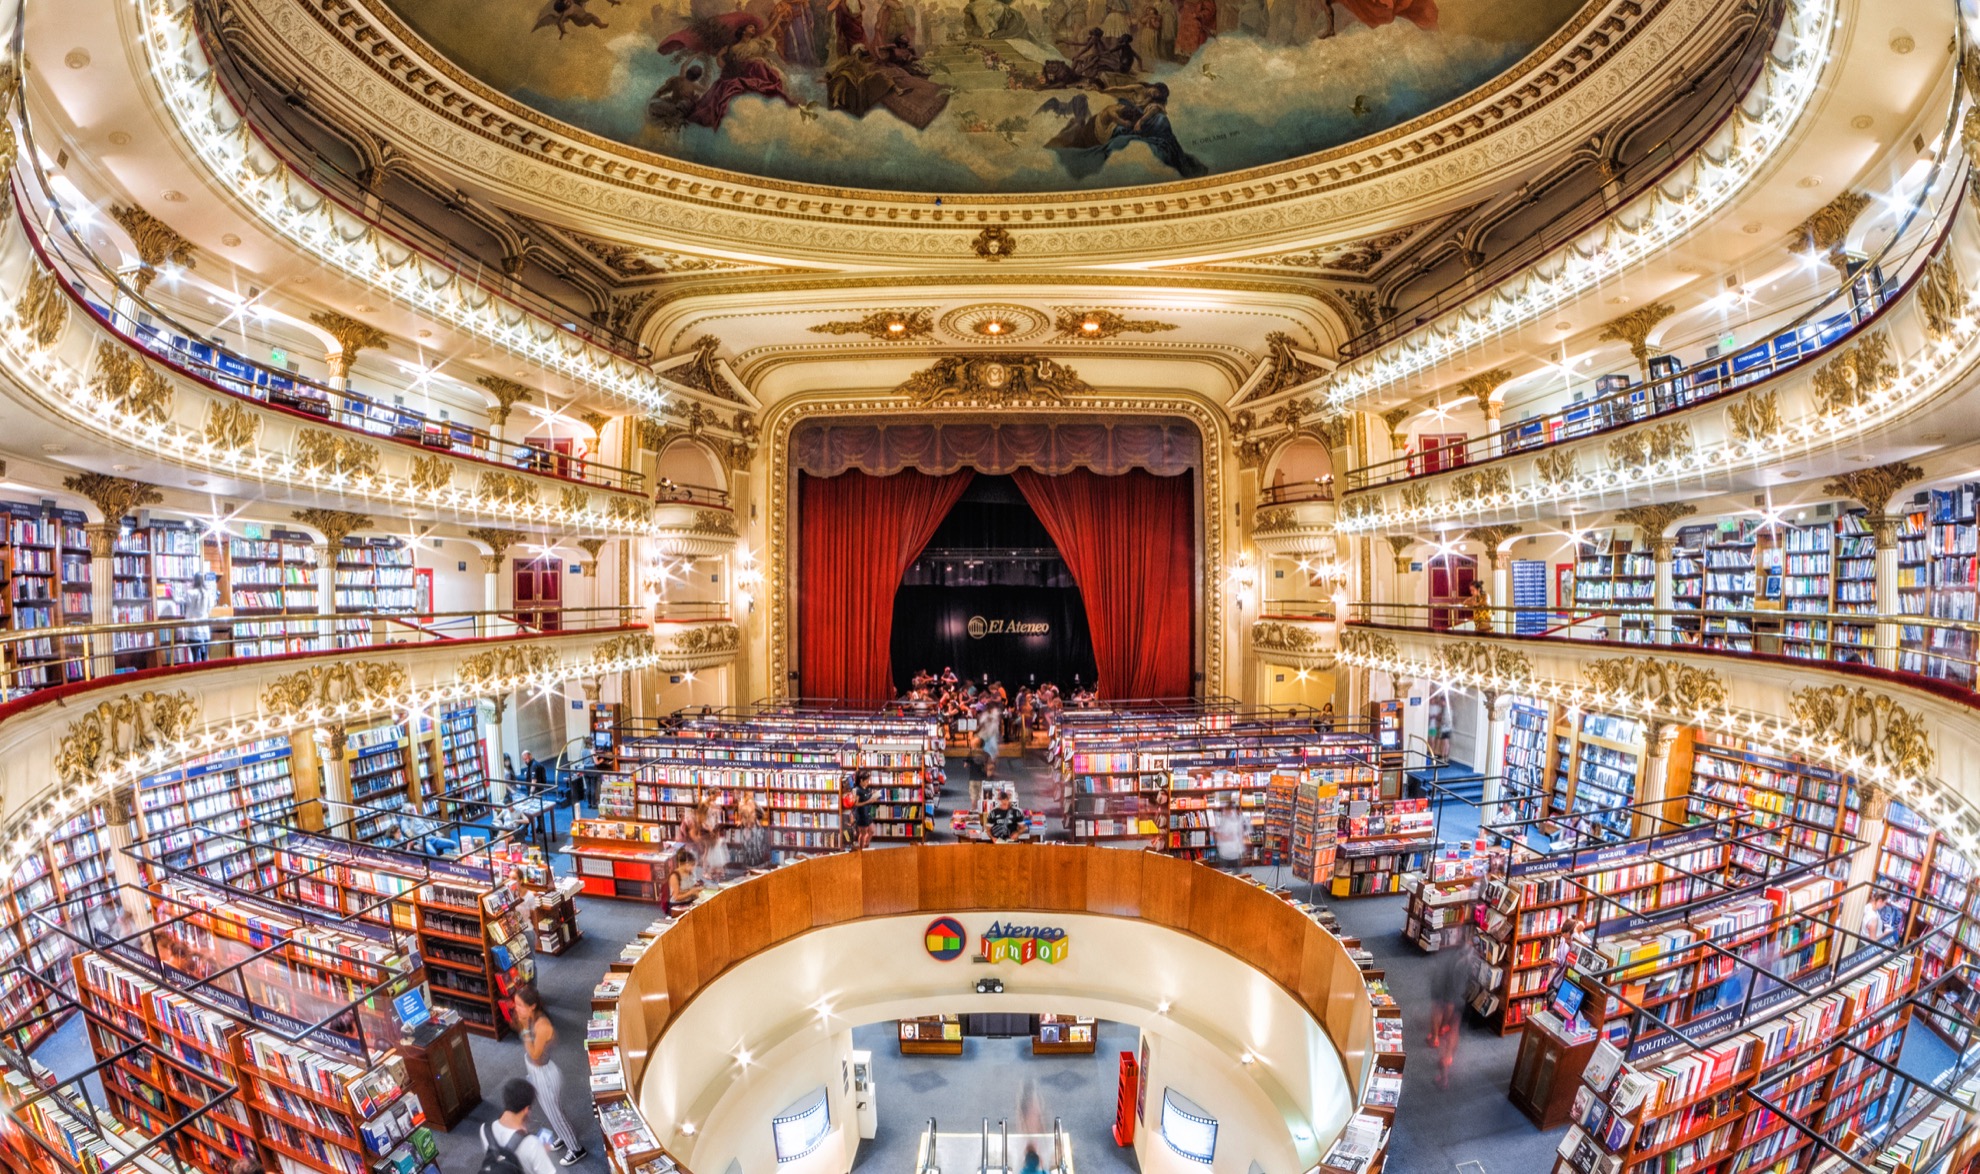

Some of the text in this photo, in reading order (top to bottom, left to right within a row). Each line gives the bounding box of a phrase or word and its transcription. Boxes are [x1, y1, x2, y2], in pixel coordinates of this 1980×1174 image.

[988, 619, 1050, 634] El Ateneo
[985, 919, 1065, 939] Ateneo
[982, 940, 1067, 960] Junior
[1751, 993, 1780, 1011] POLITICA
[261, 1010, 305, 1031] LITERATURA
[1637, 1033, 1674, 1054] POLITICA
